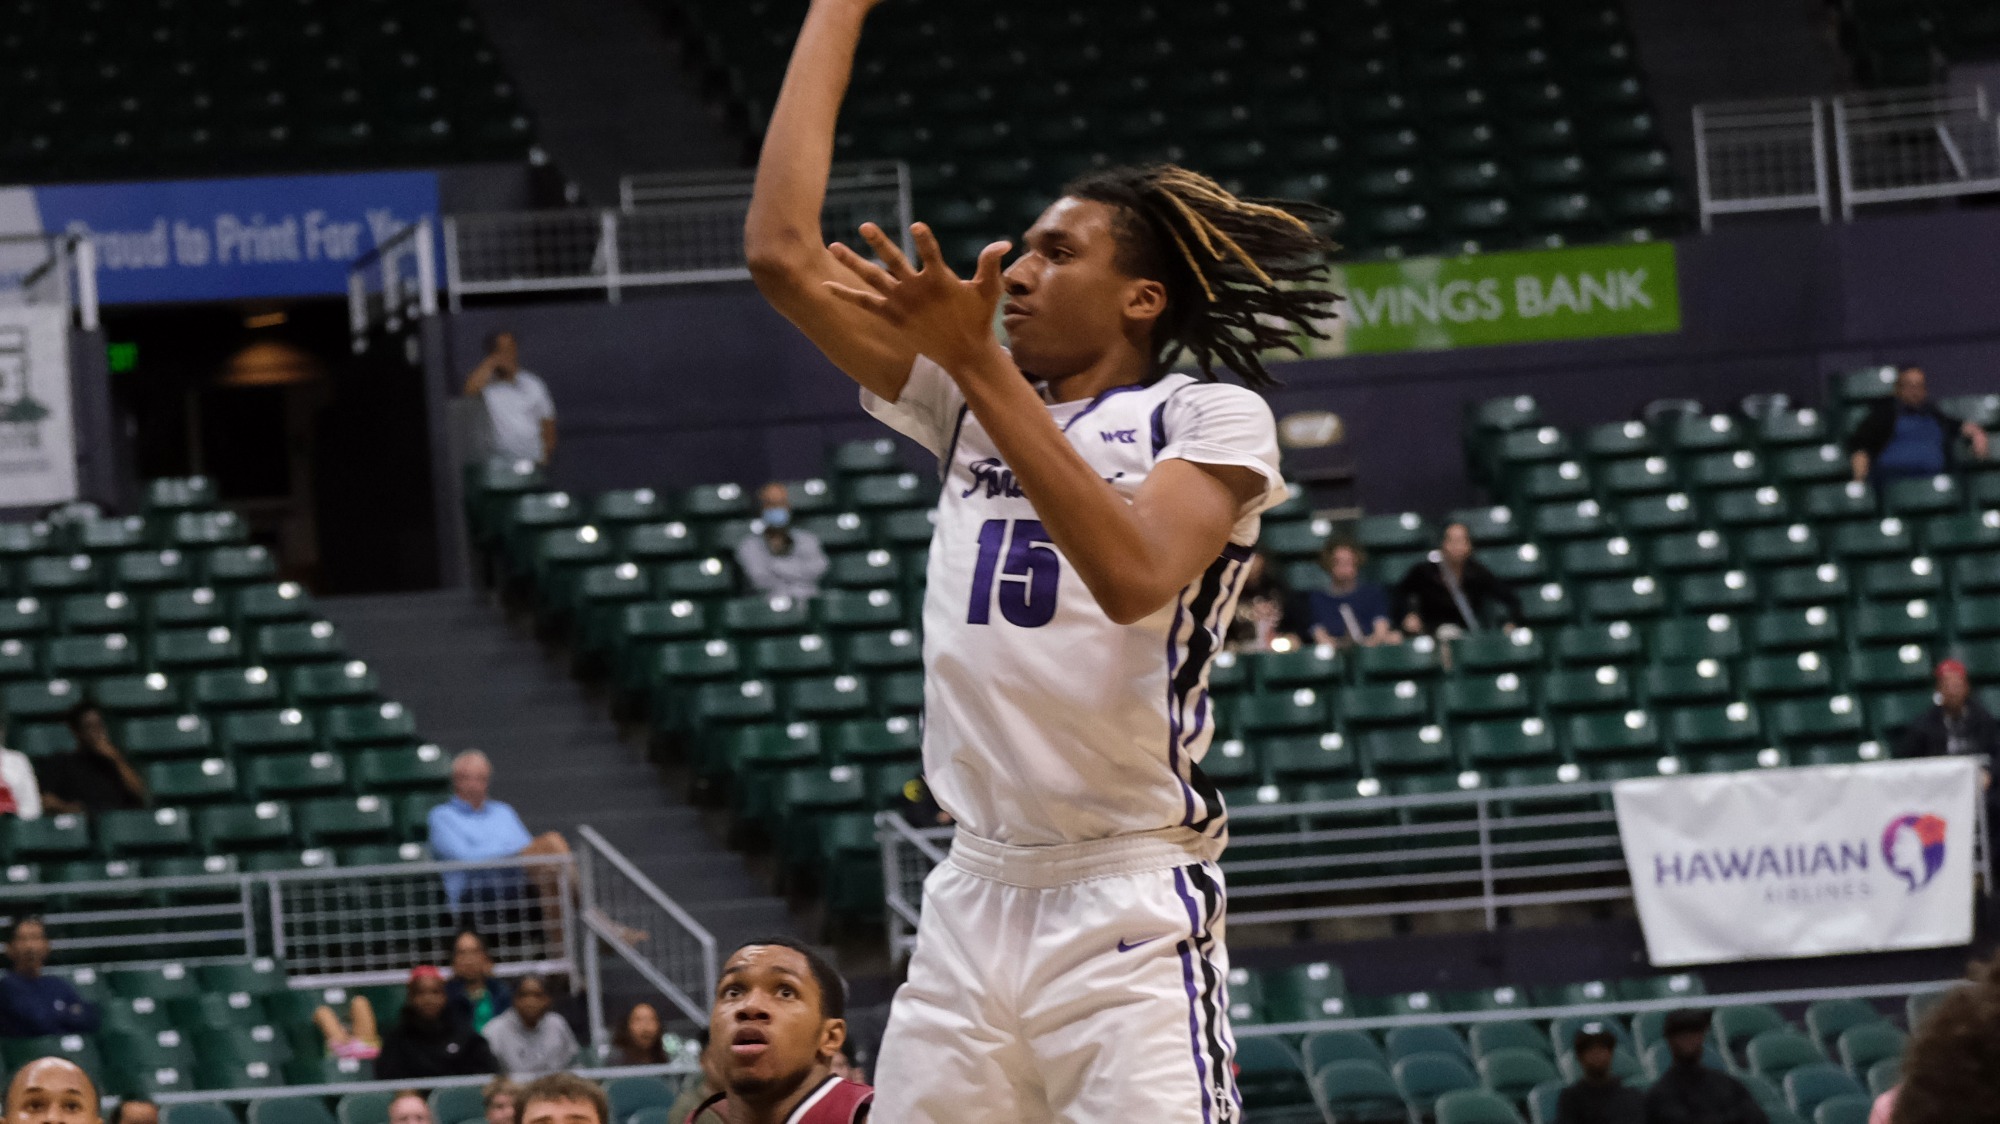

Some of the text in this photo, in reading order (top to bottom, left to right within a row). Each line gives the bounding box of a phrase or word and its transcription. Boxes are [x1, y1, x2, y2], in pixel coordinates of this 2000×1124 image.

[173, 219, 210, 266] to
[215, 212, 300, 264] Print
[303, 209, 361, 262] For
[1328, 267, 1654, 329] AVINGS BANK
[967, 519, 1060, 628] 15
[1654, 840, 1870, 886] HAWAIIAN
